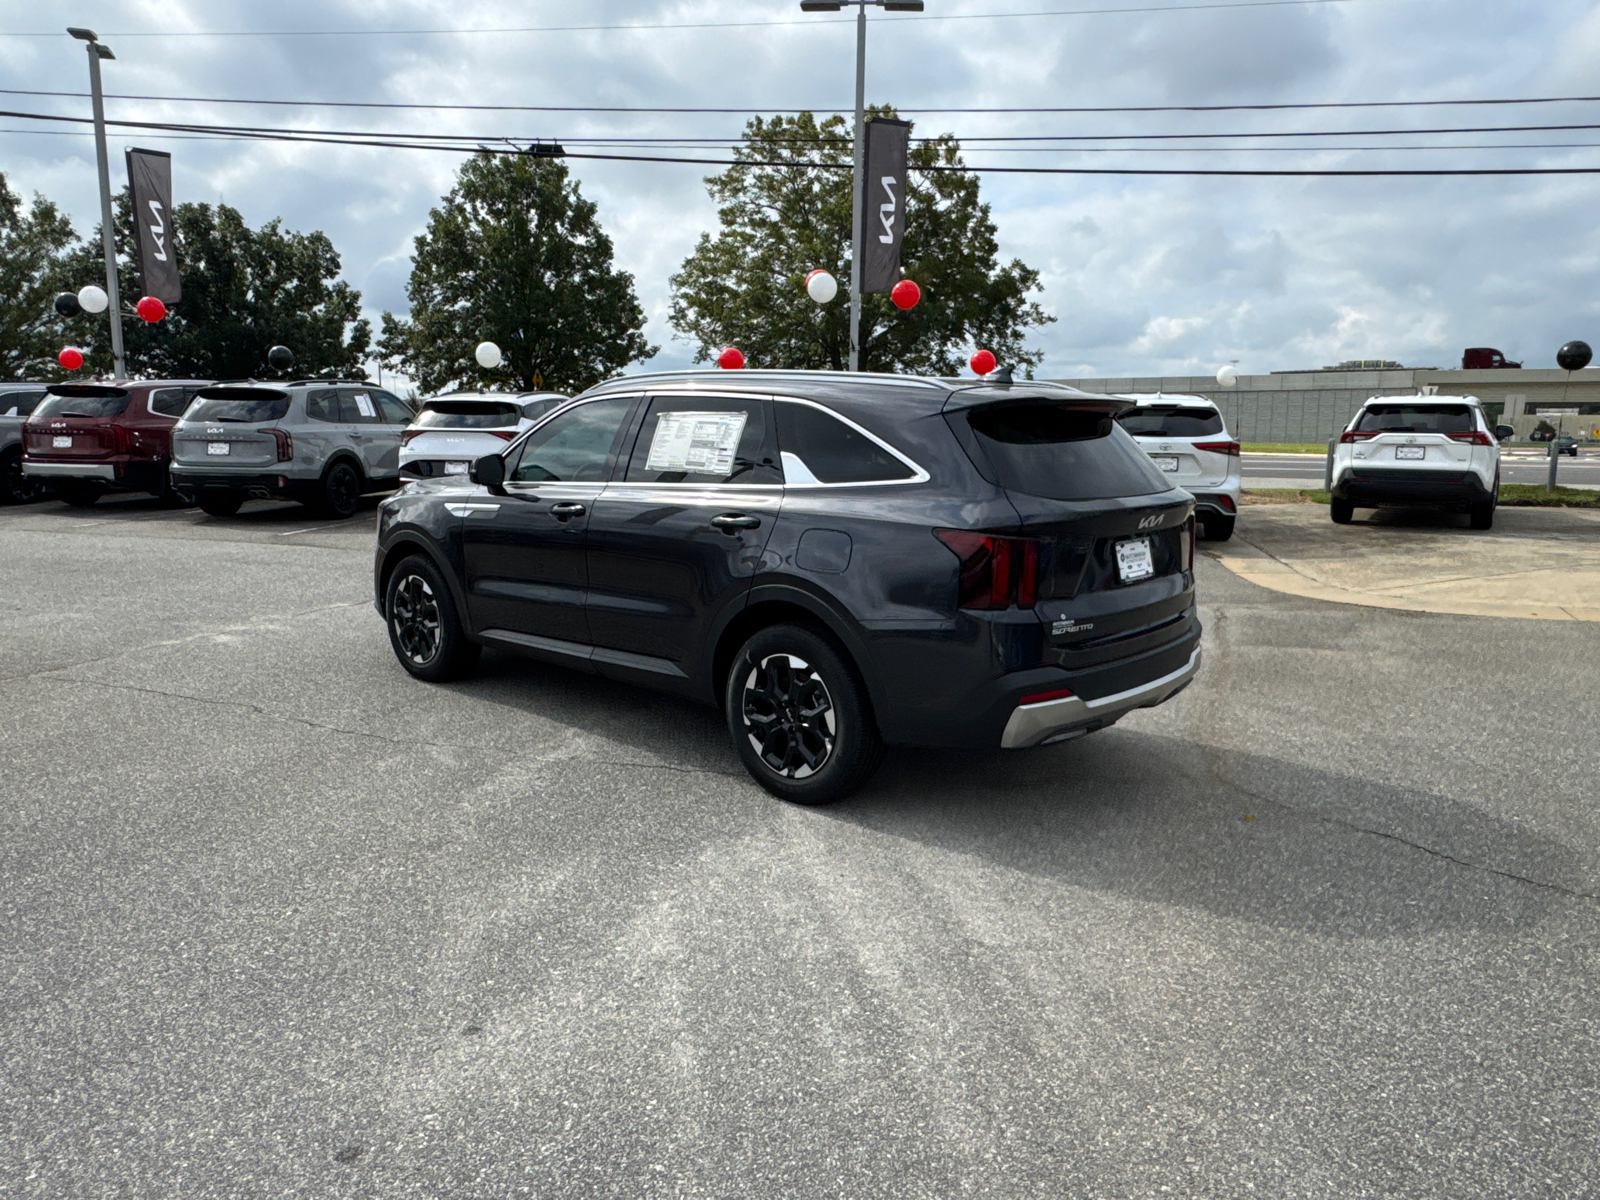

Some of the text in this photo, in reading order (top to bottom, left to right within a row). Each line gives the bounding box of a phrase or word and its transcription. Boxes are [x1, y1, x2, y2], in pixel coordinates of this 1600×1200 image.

[148, 200, 167, 262] KIA
[878, 176, 897, 245] KIA
[1138, 513, 1165, 530] KIA
